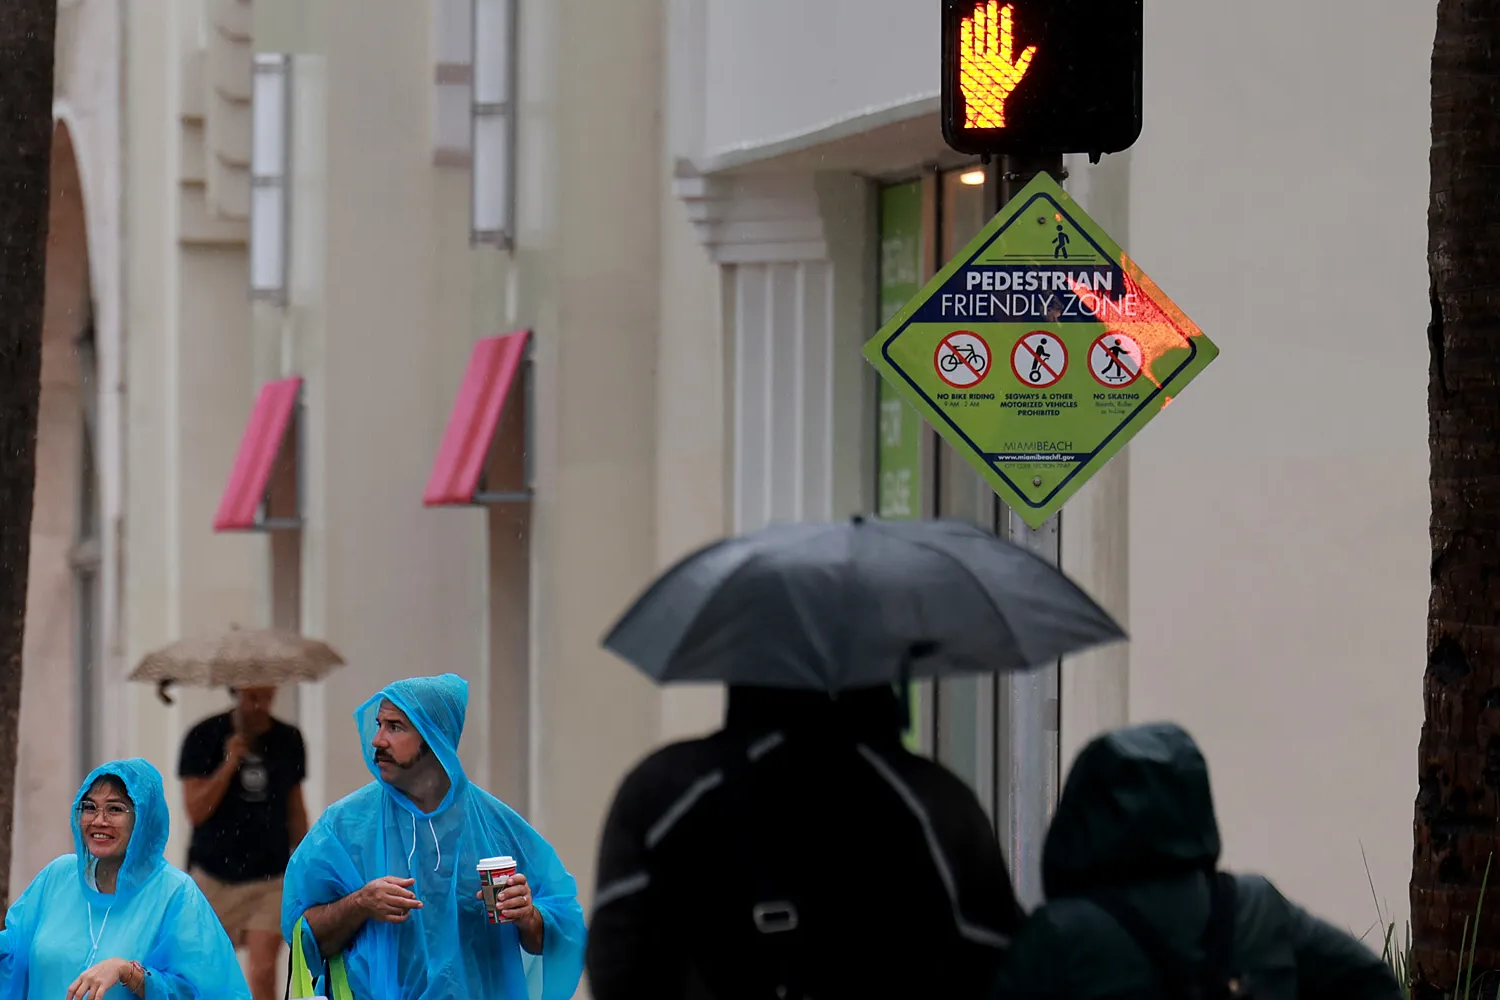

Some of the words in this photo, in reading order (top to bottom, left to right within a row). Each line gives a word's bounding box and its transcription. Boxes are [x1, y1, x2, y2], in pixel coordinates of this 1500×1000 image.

[966, 271, 1113, 291] PEDESTRIAN
[941, 293, 1054, 316] FRIENDLY
[1062, 293, 1138, 316] ZONE
[998, 454, 1075, 462] www.miamibeachfl.gov
